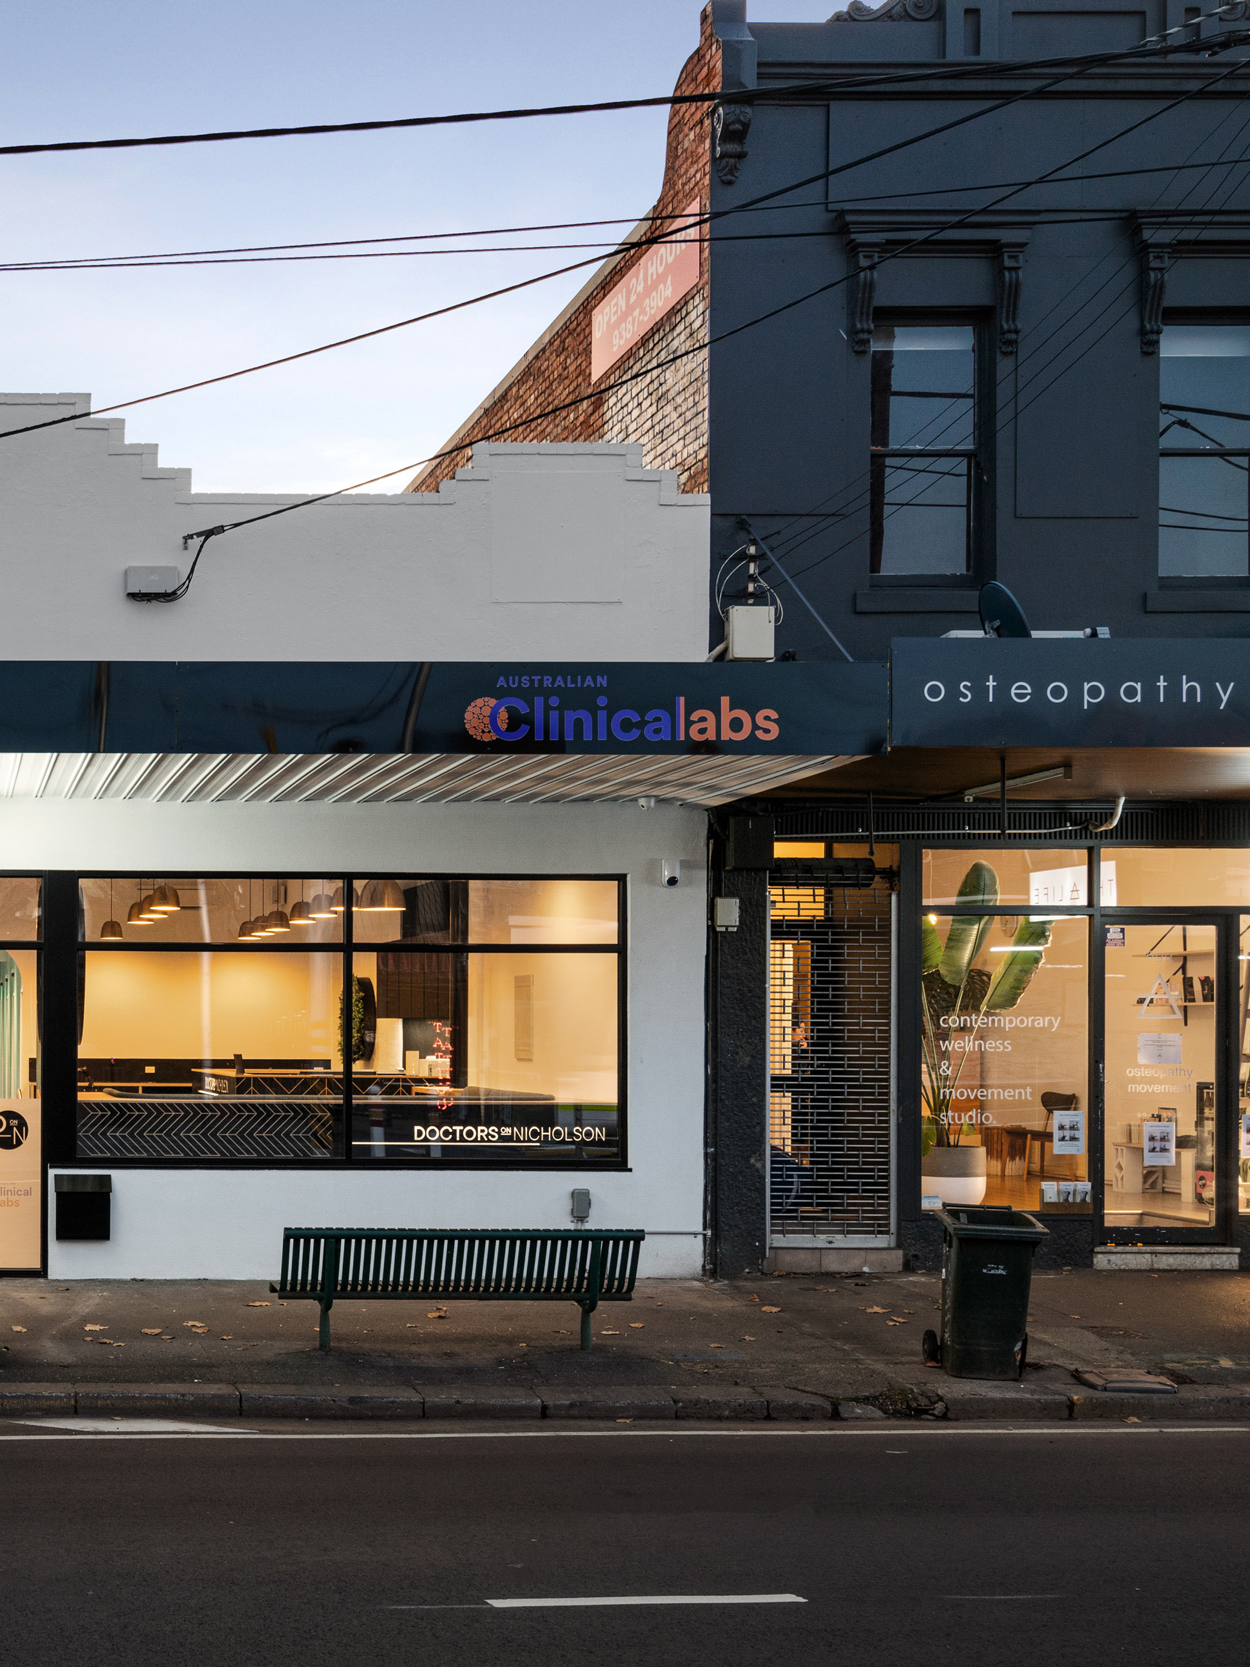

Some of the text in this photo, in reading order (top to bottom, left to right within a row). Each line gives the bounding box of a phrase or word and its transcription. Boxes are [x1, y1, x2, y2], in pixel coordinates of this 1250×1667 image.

[595, 216, 695, 339] OPEN 24 HOURS
[612, 275, 673, 352] 9387-3904
[497, 675, 608, 688] AUSTRALIAN
[924, 675, 1235, 709] osteopathy
[939, 1013, 1061, 1032] contemporary
[939, 1035, 1012, 1052] wellness
[939, 1060, 952, 1076] &
[1126, 1067, 1193, 1079] osteopathy
[939, 1086, 1033, 1100] movement
[1128, 1083, 1192, 1093] movement
[939, 1108, 997, 1125] studio.
[413, 1125, 499, 1141] DOCTORS
[513, 1126, 606, 1142] NICHOLSON
